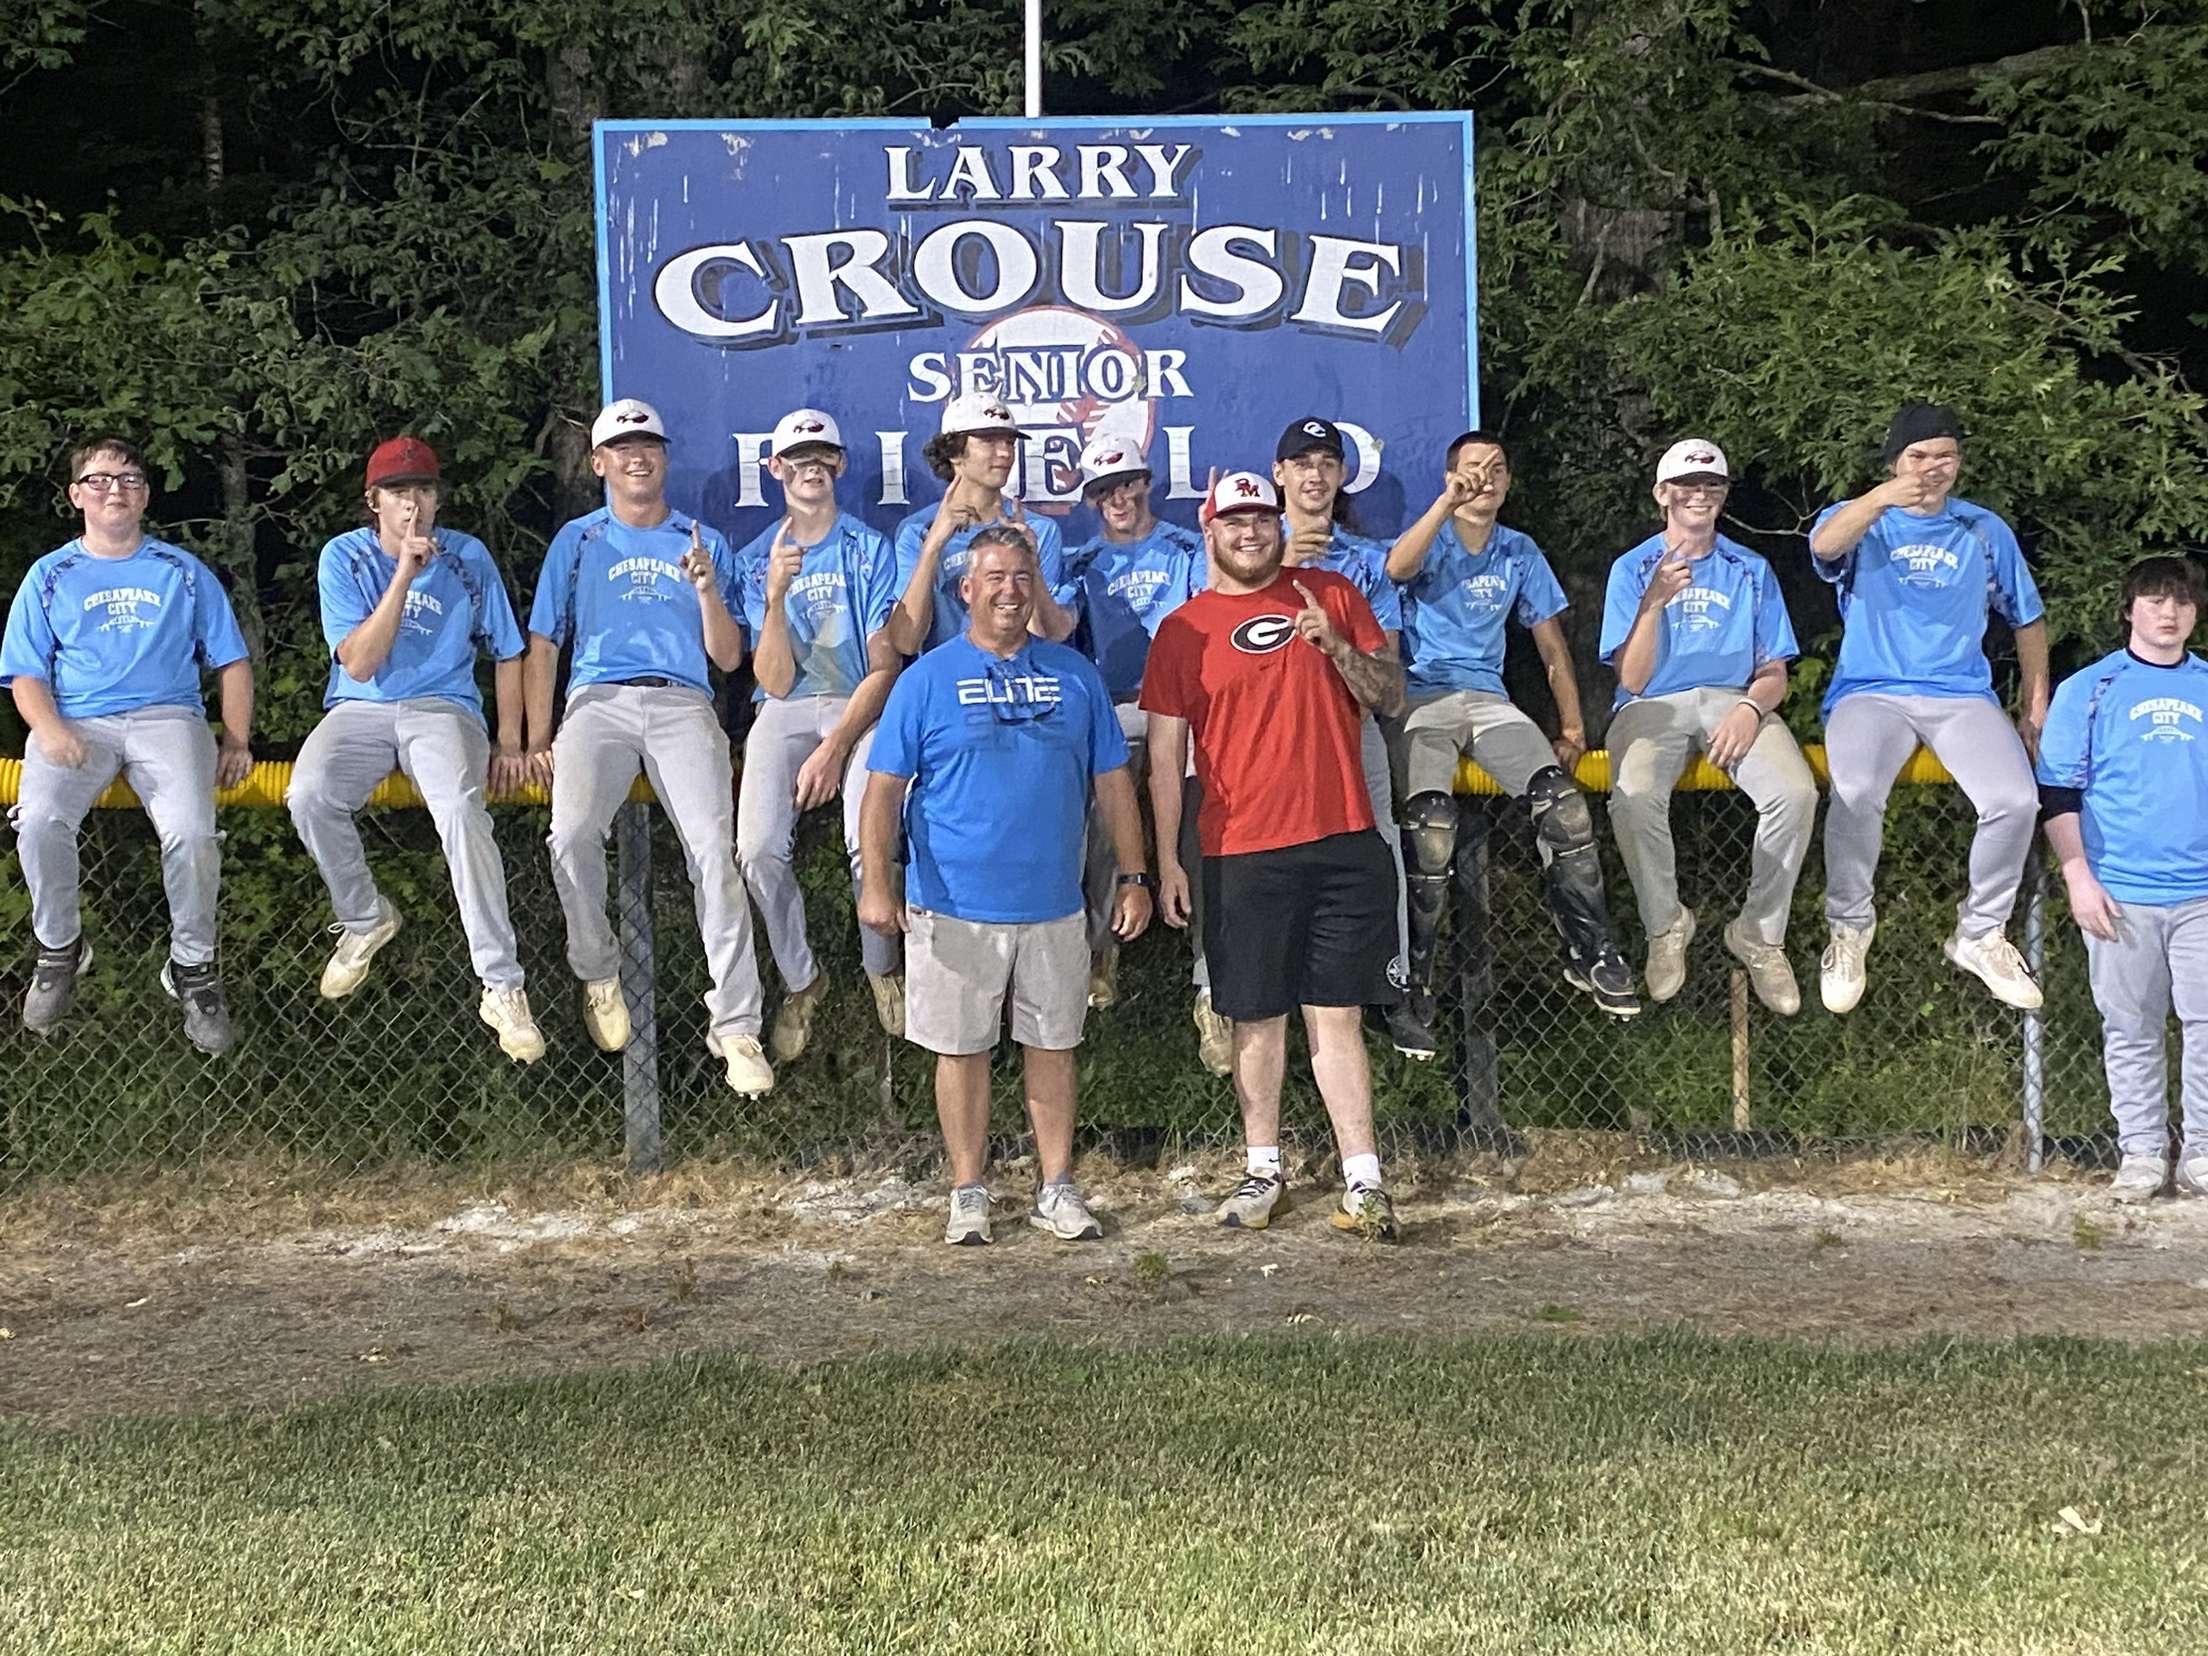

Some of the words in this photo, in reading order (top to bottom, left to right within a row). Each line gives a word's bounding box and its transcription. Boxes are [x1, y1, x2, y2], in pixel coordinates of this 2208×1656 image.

[886, 144, 1194, 201] LARRY
[654, 219, 1402, 337] CROUSE
[907, 349, 1194, 403] SENIOR
[631, 571, 658, 585] CITY
[807, 586, 833, 602] CITY
[1127, 584, 1154, 598] CITY
[107, 601, 137, 615] CITY
[1683, 601, 1709, 613] CITY
[1246, 621, 1290, 646] G
[956, 676, 1062, 704] ELITE
[2152, 710, 2180, 725] CITY
